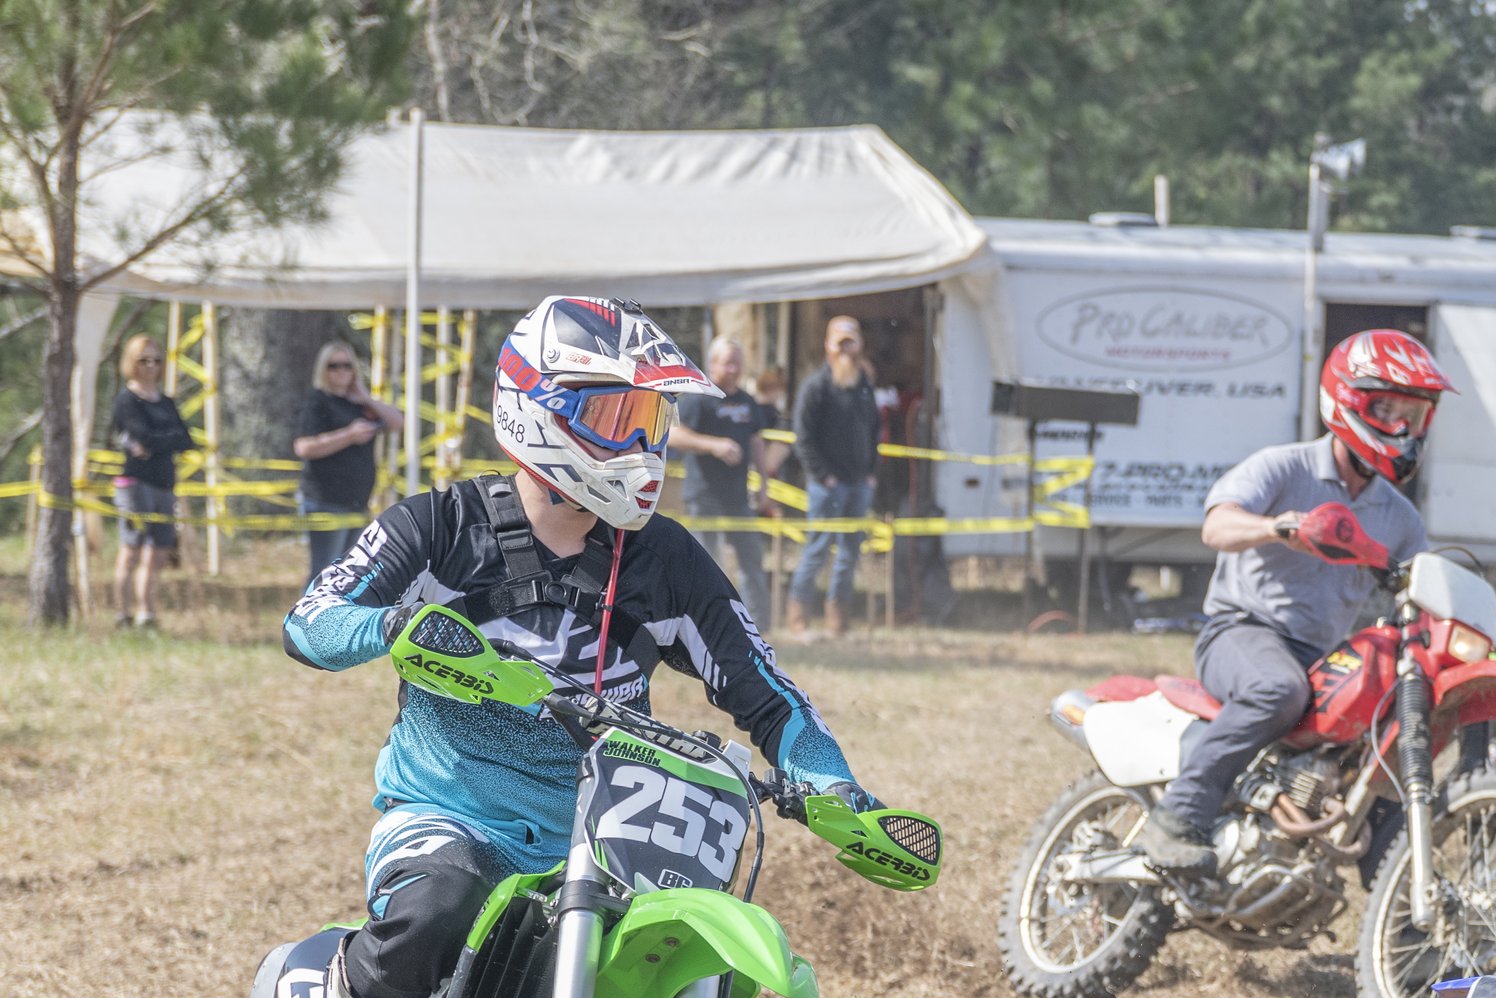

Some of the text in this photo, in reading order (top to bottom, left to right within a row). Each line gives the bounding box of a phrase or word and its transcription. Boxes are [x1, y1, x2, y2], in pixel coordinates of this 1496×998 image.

[1068, 303, 1271, 347] PRO CALIBER
[497, 346, 567, 411] 100%
[496, 405, 526, 444] 9848
[404, 653, 495, 695] ACERBIS
[602, 748, 662, 767] JOHNSON
[607, 739, 656, 757] WALKER
[595, 765, 747, 883] 253
[846, 841, 931, 882] ACERBIS
